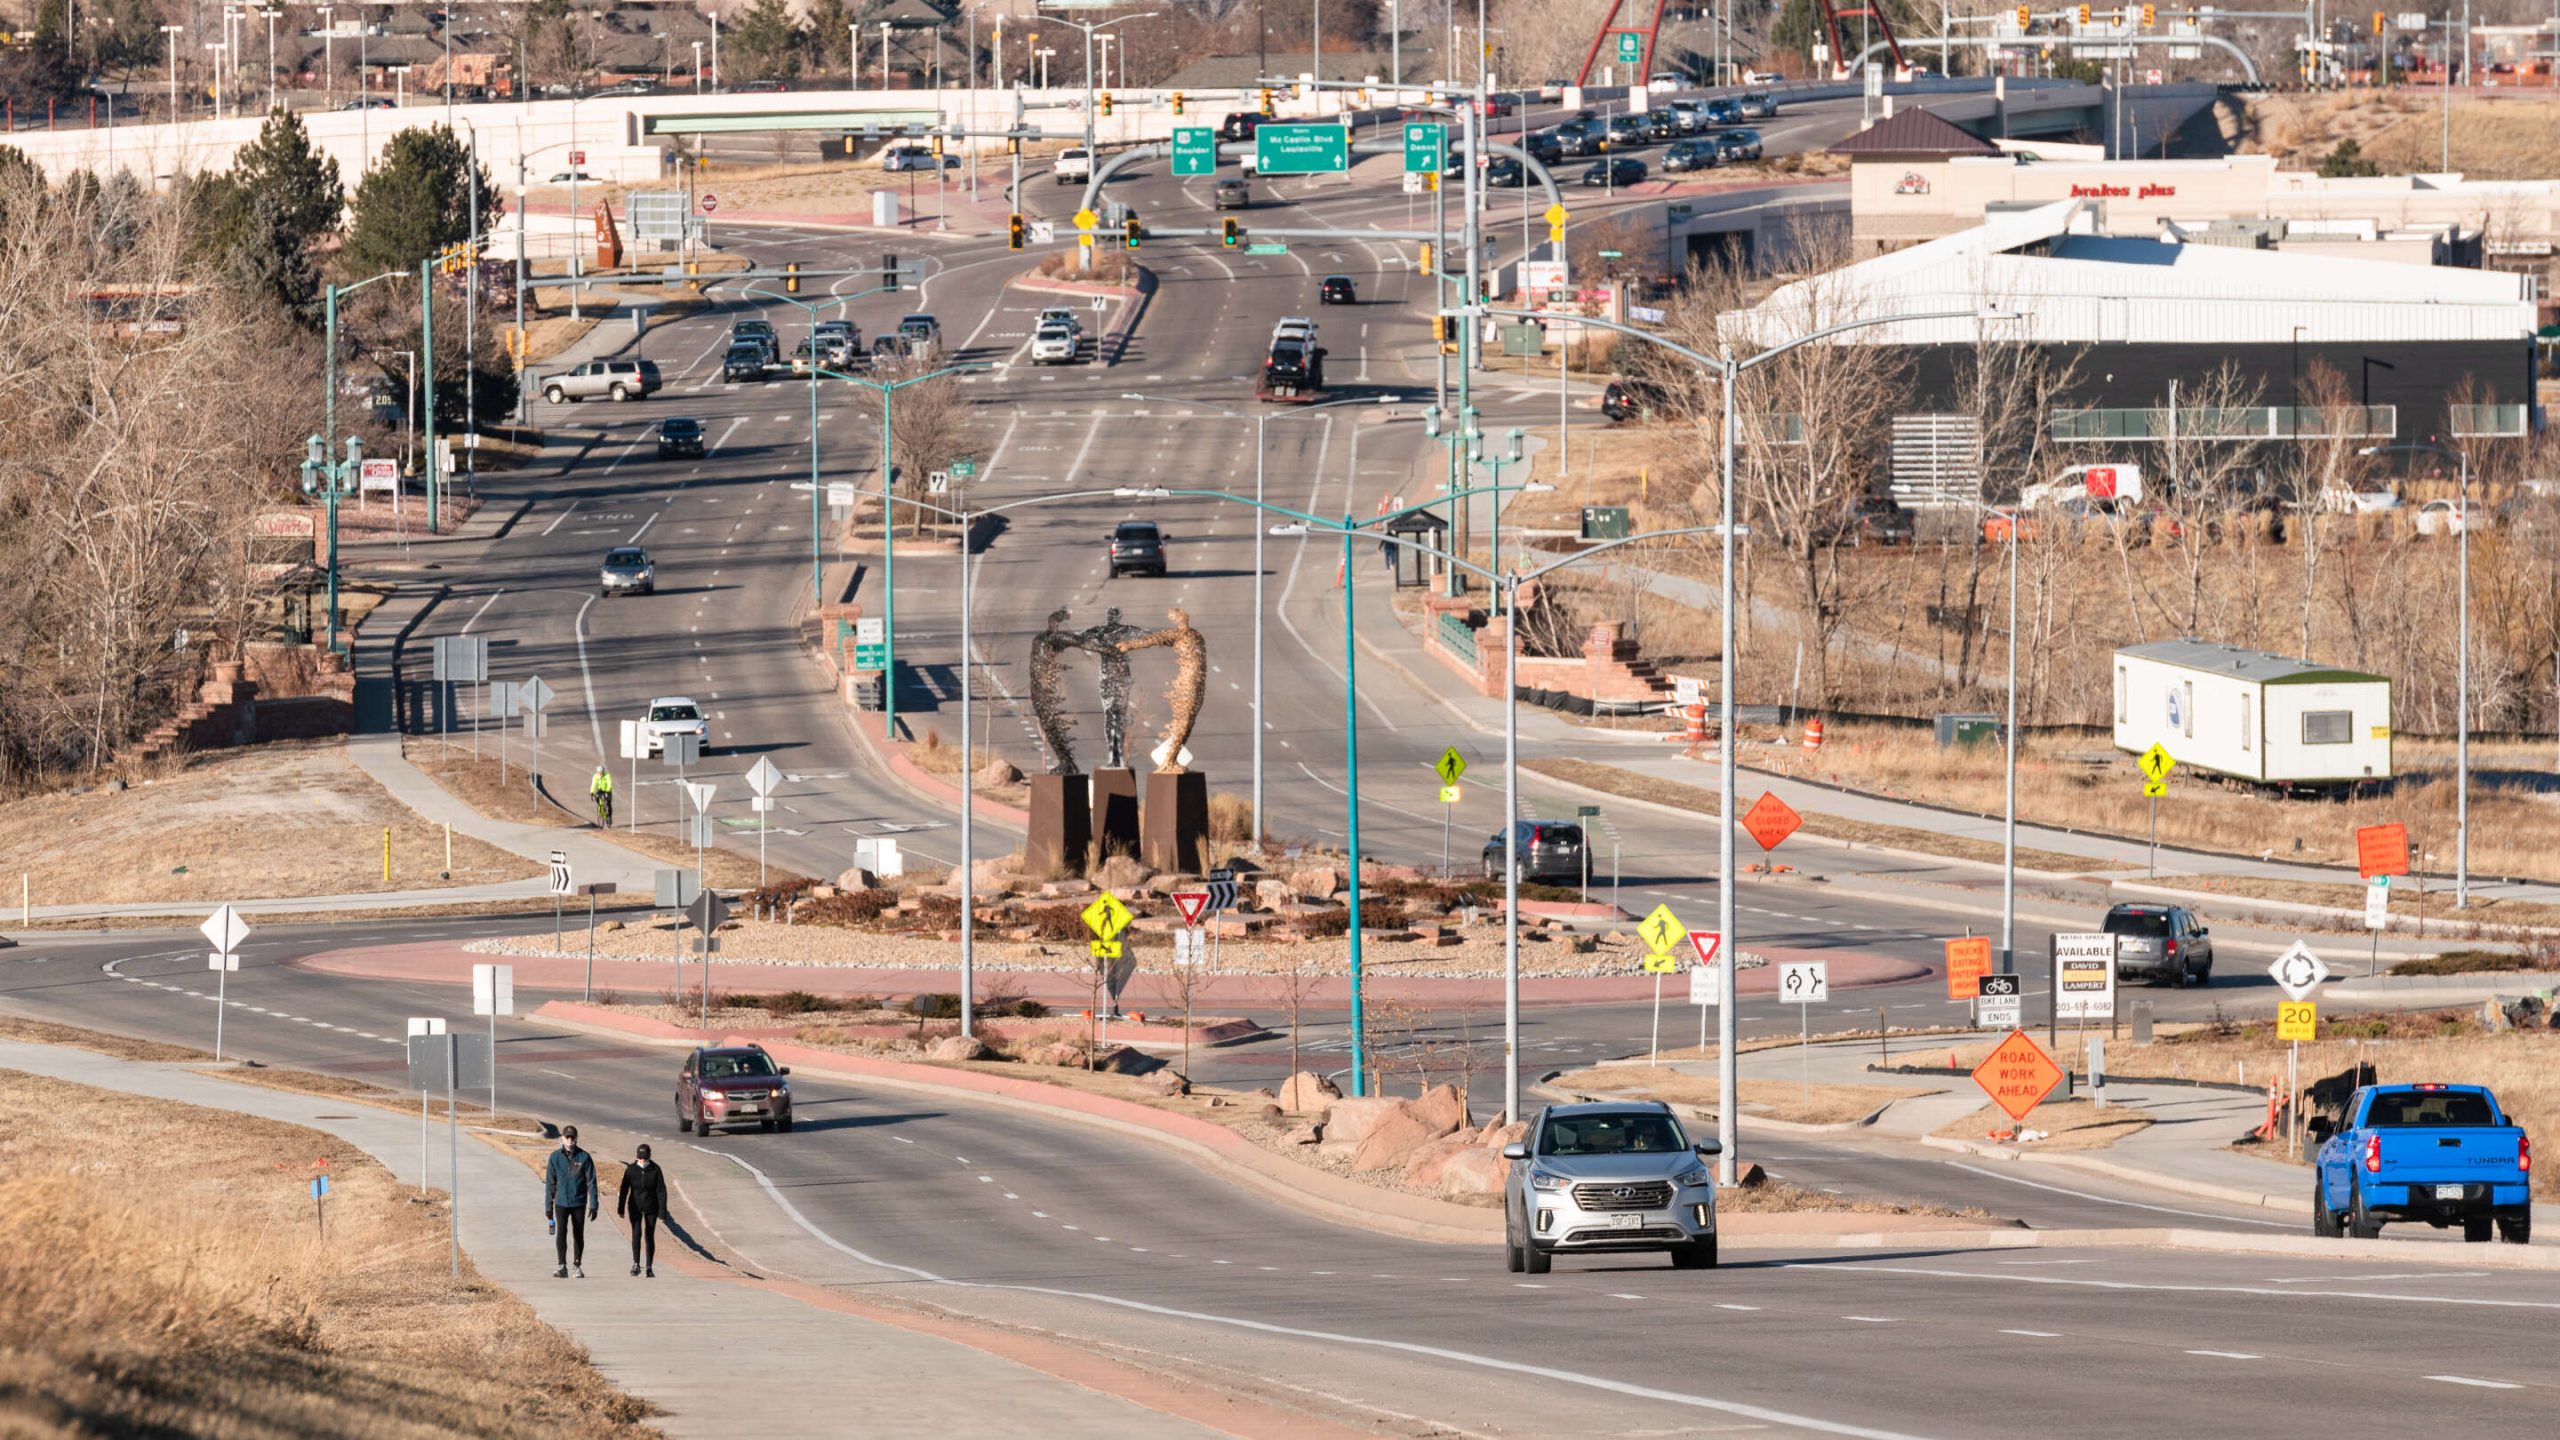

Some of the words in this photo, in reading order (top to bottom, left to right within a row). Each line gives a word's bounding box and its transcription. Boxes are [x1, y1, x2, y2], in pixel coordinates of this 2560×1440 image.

[2070, 184, 2130, 198] brakes
[2138, 183, 2176, 199] plus
[1760, 804, 1784, 812] ROAD
[1756, 816, 1789, 825] CLOSED
[1757, 828, 1787, 837] AHEAD
[2056, 947, 2112, 957] AVAILABLE
[2065, 981, 2104, 989] LAMPERT
[1988, 1013, 2012, 1022] ENDS
[2284, 1007, 2312, 1024] 20
[2000, 1052, 2035, 1063] ROAD
[2000, 1068, 2036, 1080] WORK
[1998, 1085, 2038, 1096] AHEAD
